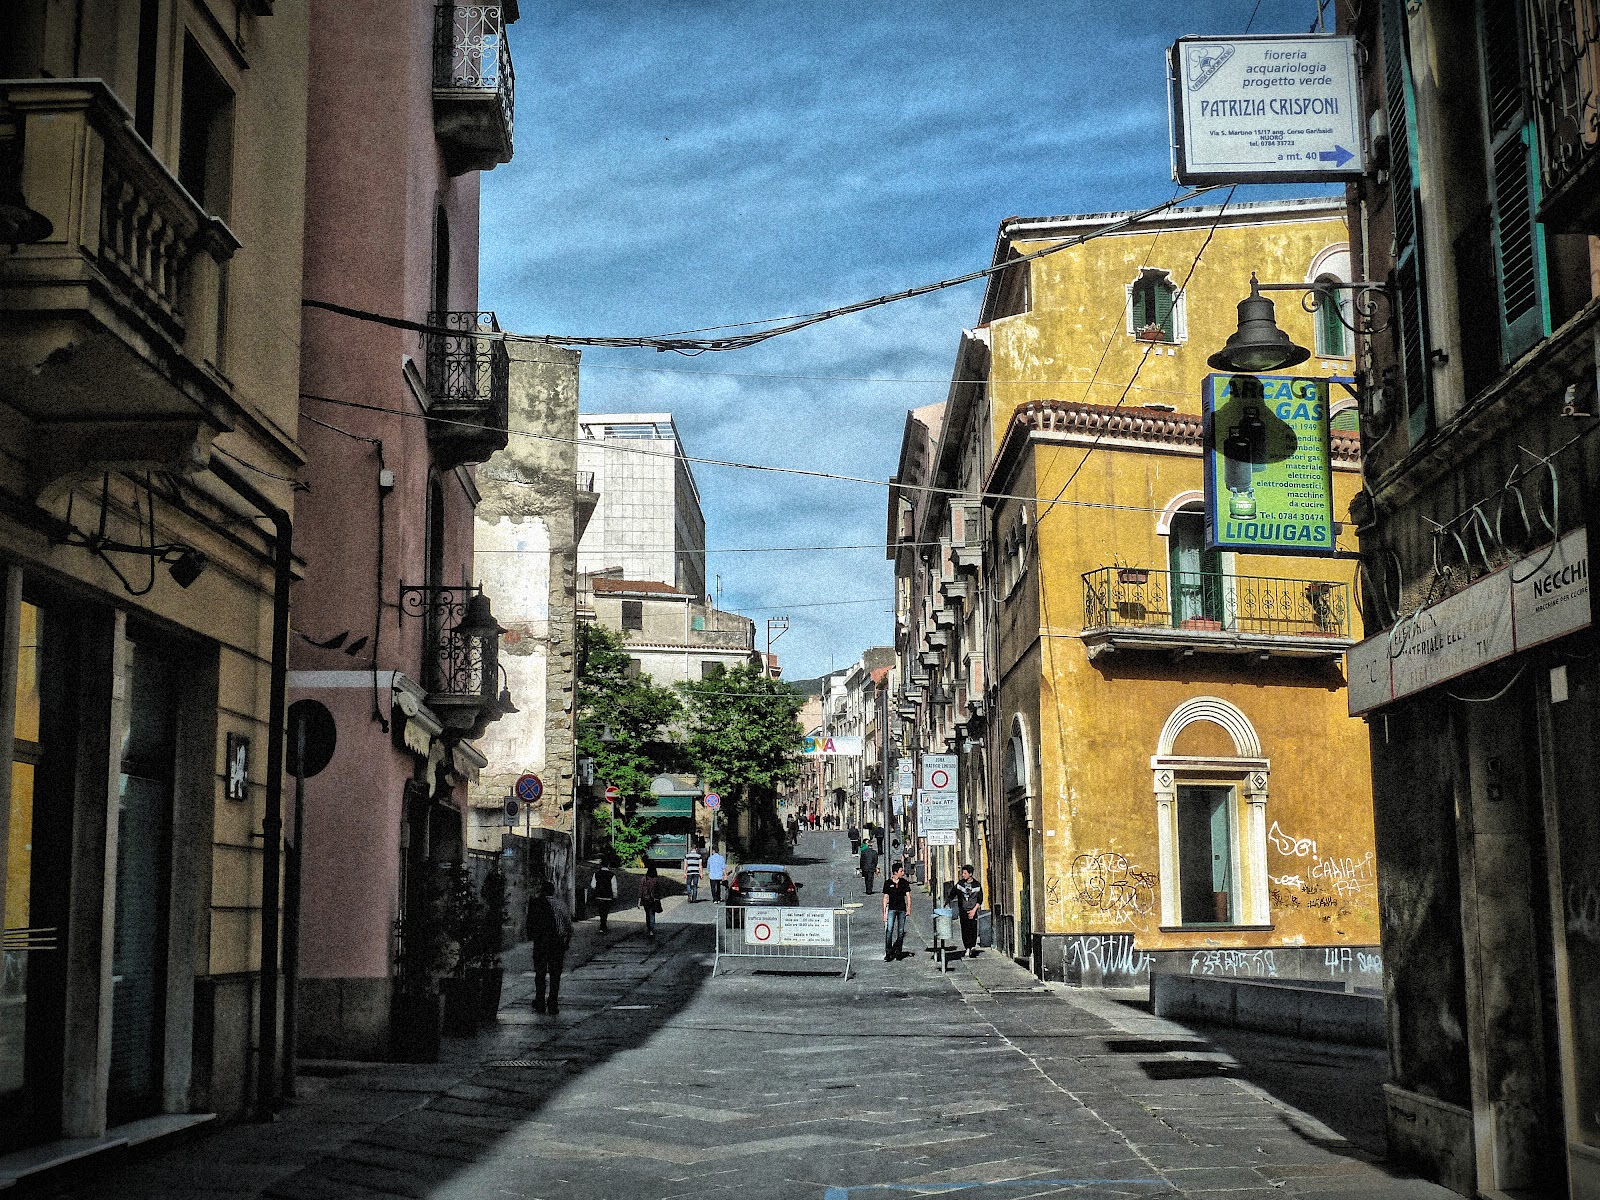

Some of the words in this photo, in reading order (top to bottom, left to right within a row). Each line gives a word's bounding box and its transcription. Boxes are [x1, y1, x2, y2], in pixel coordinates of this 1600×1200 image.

[1264, 50, 1307, 60] fioreria
[1246, 63, 1327, 74] acquariologia
[1242, 76, 1295, 89] progetto
[1299, 75, 1332, 86] verde
[1201, 99, 1266, 117] PATRIZIA
[1269, 98, 1339, 116] CRISPONI
[1277, 153, 1284, 161] a
[1286, 151, 1303, 161] mt.
[1305, 151, 1318, 160] 40
[1220, 379, 1293, 400] ARCA
[1275, 402, 1324, 421] GAS
[1300, 423, 1317, 431] 1949
[1285, 463, 1324, 471] materiale
[1287, 491, 1324, 499] macchine
[1259, 511, 1276, 520] Tel.
[1278, 512, 1298, 520] 0784
[1225, 521, 1327, 542] LIQUIGAS
[1533, 558, 1587, 599] NECCHI
